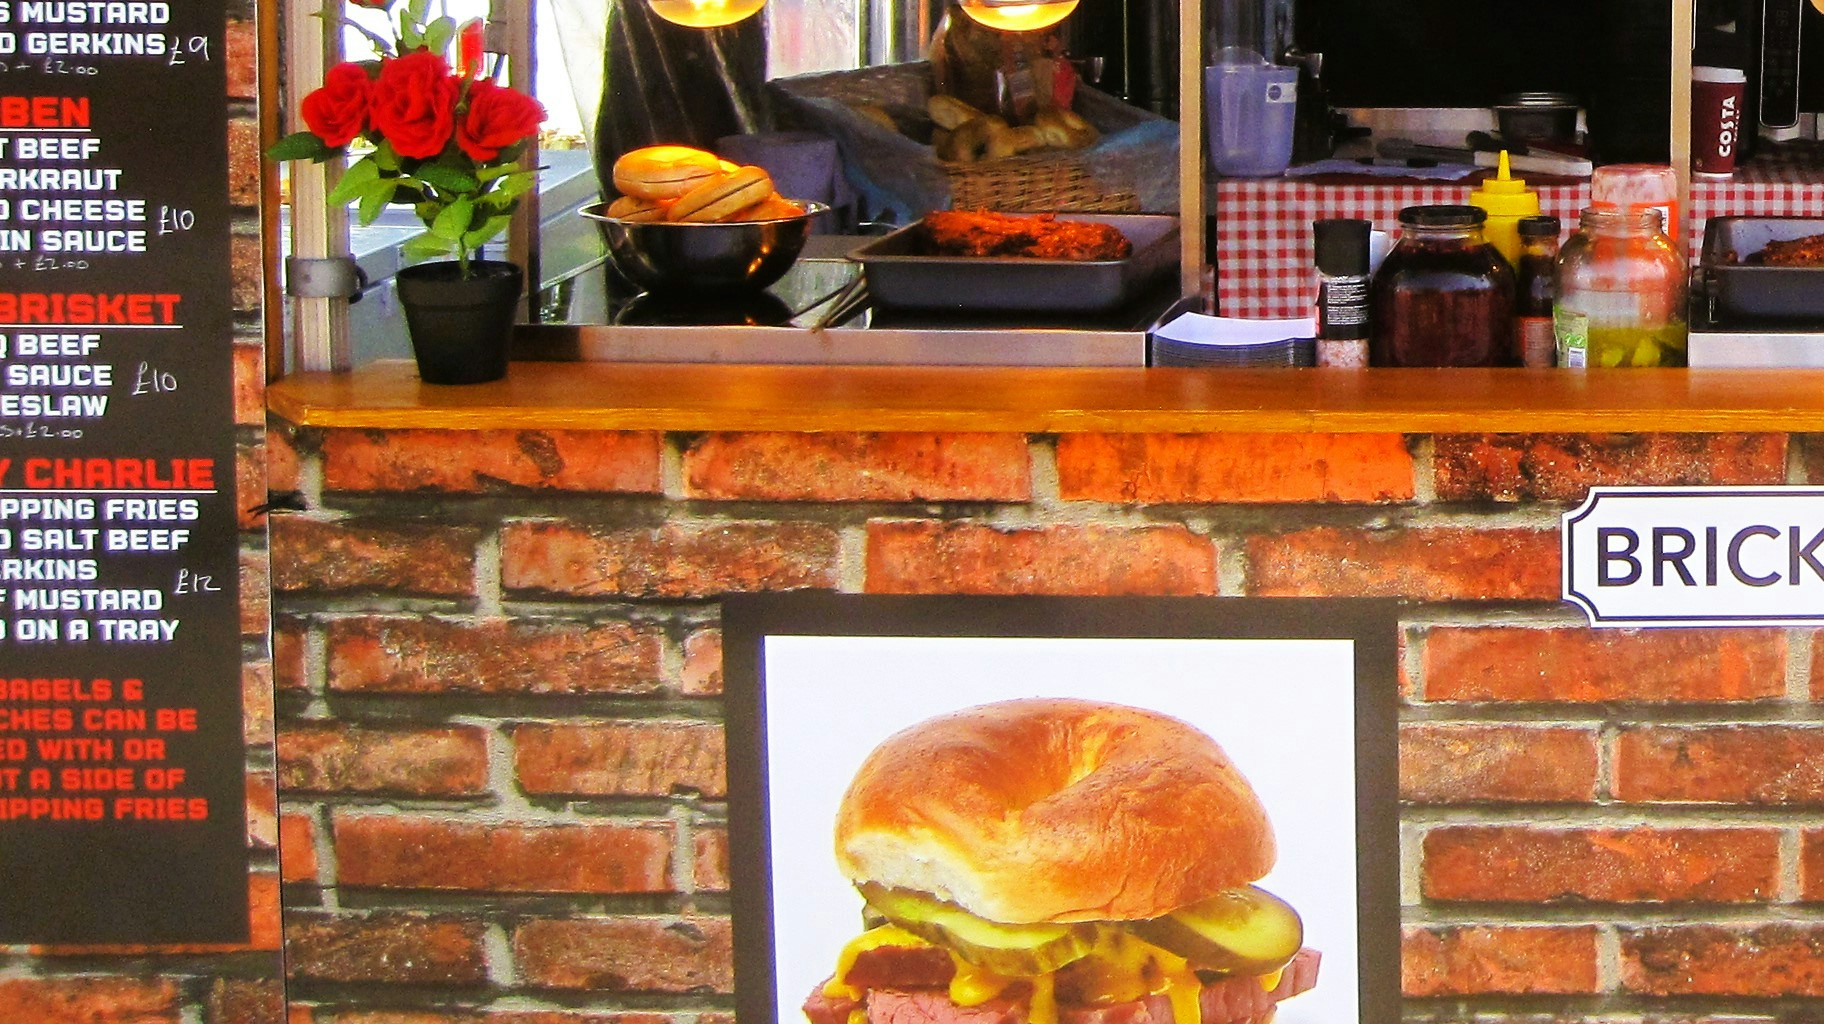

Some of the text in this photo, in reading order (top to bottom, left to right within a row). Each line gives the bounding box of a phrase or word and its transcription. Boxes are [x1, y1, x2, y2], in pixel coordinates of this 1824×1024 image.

[21, 2, 170, 25] MUSTARD
[28, 33, 166, 55] GERKINS
[168, 36, 210, 67] £9
[1718, 95, 1736, 157] COSTA
[18, 138, 100, 160] BEEF
[22, 199, 146, 222] CHEESE
[159, 208, 195, 235] £10
[42, 230, 147, 252] SAUCE
[18, 334, 101, 356] BEEF
[9, 365, 112, 387] SAUCE
[132, 361, 178, 396] £10
[24, 458, 215, 490] CHARLIE
[106, 499, 199, 521] FRIES
[22, 529, 190, 551] SALT BEEF
[176, 568, 220, 594] £12
[15, 589, 162, 611] MUSTARD
[16, 619, 179, 641] ON A TRAY
[122, 679, 143, 700] &
[83, 709, 146, 730] CAN
[156, 709, 198, 730] BE
[37, 739, 113, 760] WITH
[123, 739, 166, 760] OR
[30, 768, 186, 790] A SIDE OF
[114, 798, 208, 820] FRIES
